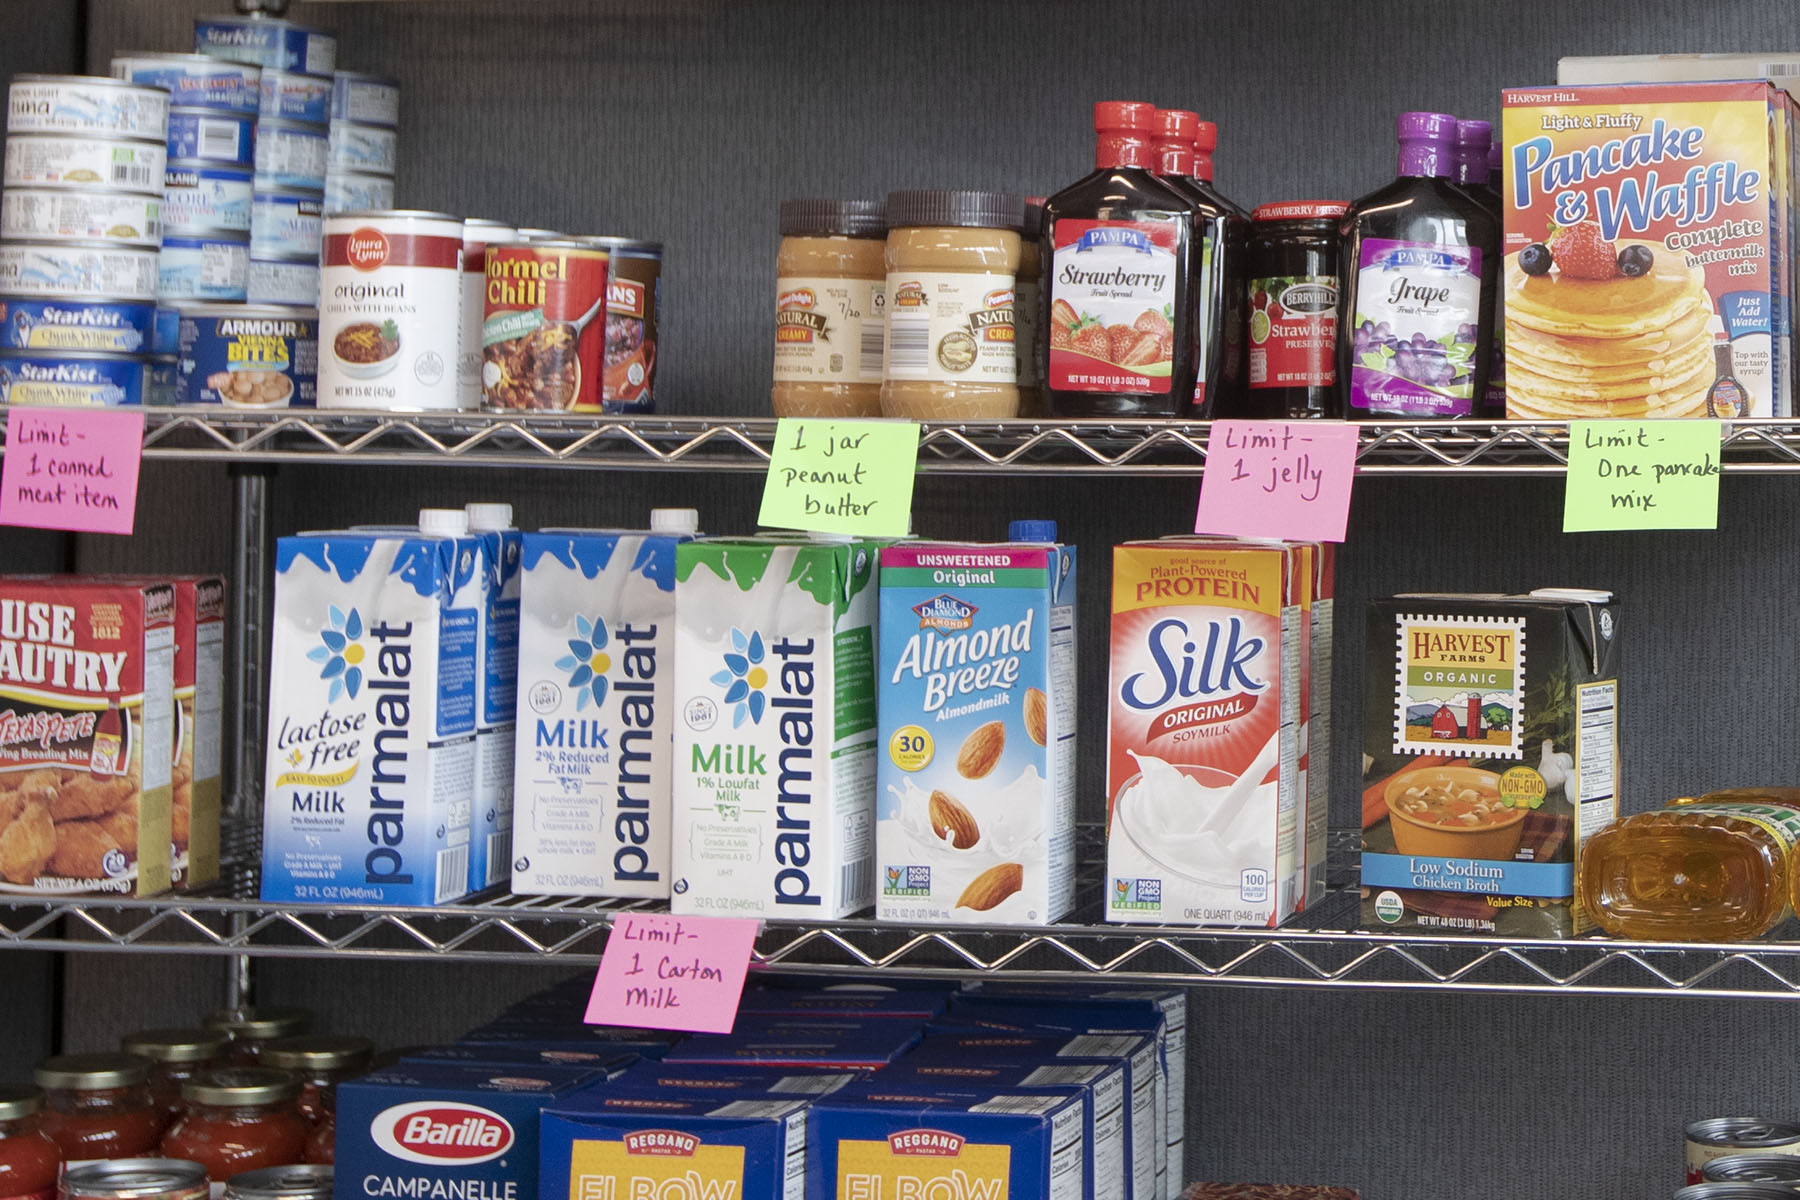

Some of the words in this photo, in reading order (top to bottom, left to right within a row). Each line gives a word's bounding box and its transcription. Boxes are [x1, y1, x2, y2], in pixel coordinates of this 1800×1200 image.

[1507, 93, 1552, 104] HARVEST
[1553, 92, 1576, 102] HILL
[1541, 115, 1581, 131] Light
[1583, 117, 1592, 128] &
[1595, 114, 1642, 132] Fluffy
[1512, 118, 1705, 209] Pancake
[1555, 191, 1589, 227] &
[1595, 161, 1760, 243] Waffle
[350, 238, 383, 253] Laura
[1090, 230, 1138, 245] PAMPA
[1665, 220, 1763, 251] Complete
[356, 248, 386, 263] Lynn
[1397, 251, 1446, 267] PAMPA
[1685, 244, 1765, 269] buttermilk
[1059, 263, 1167, 292] Strawberry
[1728, 262, 1758, 276] mix
[334, 280, 405, 302] original
[488, 280, 547, 306] Chili
[1388, 275, 1449, 310] Grape
[1737, 296, 1761, 308] Just
[1738, 307, 1761, 317] Add
[43, 307, 120, 327] StarKist
[1731, 317, 1769, 328] Water!
[220, 320, 297, 336] ARMOUR
[237, 335, 286, 346] VIENNA
[227, 345, 289, 362] BITES
[20, 363, 98, 382] StarKist
[789, 426, 807, 452] 1
[823, 426, 869, 457] jar
[27, 453, 41, 473] 1
[1598, 458, 1642, 478] One
[1651, 453, 1721, 484] pancake
[780, 463, 867, 487] peanut
[1231, 458, 1250, 482] 1
[1262, 453, 1323, 502] jelly
[18, 483, 66, 505] meat
[74, 484, 119, 510] item
[805, 493, 878, 517] butter
[1611, 490, 1656, 512] mix
[916, 554, 1011, 567] UNSWEETENED
[932, 570, 996, 587] Original
[1150, 563, 1247, 581] Plant-Powered
[1136, 577, 1260, 605] PROTEIN
[921, 605, 972, 619] DIAMOND
[934, 598, 959, 611] BLUE
[0, 600, 75, 647] USE
[924, 618, 970, 629] ALMONDS
[892, 607, 1034, 685] Almond
[1412, 631, 1511, 664] HARVEST
[1122, 617, 1270, 711] Silk
[1440, 654, 1486, 664] FARMS
[923, 655, 1020, 714] Breeze
[1423, 671, 1497, 685] ORGANIC
[935, 692, 1011, 723] Almondmilk
[1163, 700, 1244, 728] ORIGINAL
[41, 711, 97, 750] PETE
[277, 710, 366, 750] lactose
[536, 718, 609, 749] Milk
[1172, 724, 1231, 744] SOYMILK
[365, 621, 414, 885] parmalat
[613, 622, 660, 882] parmalat
[899, 735, 926, 753] 30
[21, 748, 67, 763] Breading
[68, 749, 90, 761] Mix
[308, 737, 361, 775] free
[535, 750, 555, 763] 2%
[559, 750, 609, 765] Reduced
[691, 743, 767, 776] Milk
[548, 762, 566, 775] Fat
[567, 762, 592, 776] Milk
[771, 636, 822, 907] parmalat
[697, 776, 715, 789] 1%
[718, 776, 760, 790] Lowfat
[1501, 780, 1544, 794] NON-GMO
[292, 789, 345, 813] Milk
[715, 788, 741, 802] Milk
[1409, 858, 1441, 874] Low
[1446, 860, 1503, 879] Sodium
[1244, 875, 1264, 885] 100
[1412, 874, 1462, 889] Chicken
[1466, 877, 1500, 892] Broth
[1486, 895, 1513, 908] Value
[1514, 896, 1534, 908] Size
[1184, 908, 1201, 919] ONE
[1203, 908, 1232, 920] QUART
[1233, 909, 1253, 921] (946
[625, 953, 645, 976] 1
[658, 955, 723, 982] Carton
[625, 987, 680, 1009] Milk
[403, 1116, 501, 1147] Barilla
[893, 1133, 958, 1150] REGGANO
[629, 1135, 695, 1151] REGGANO
[362, 1174, 517, 1200] CAMPANELLE
